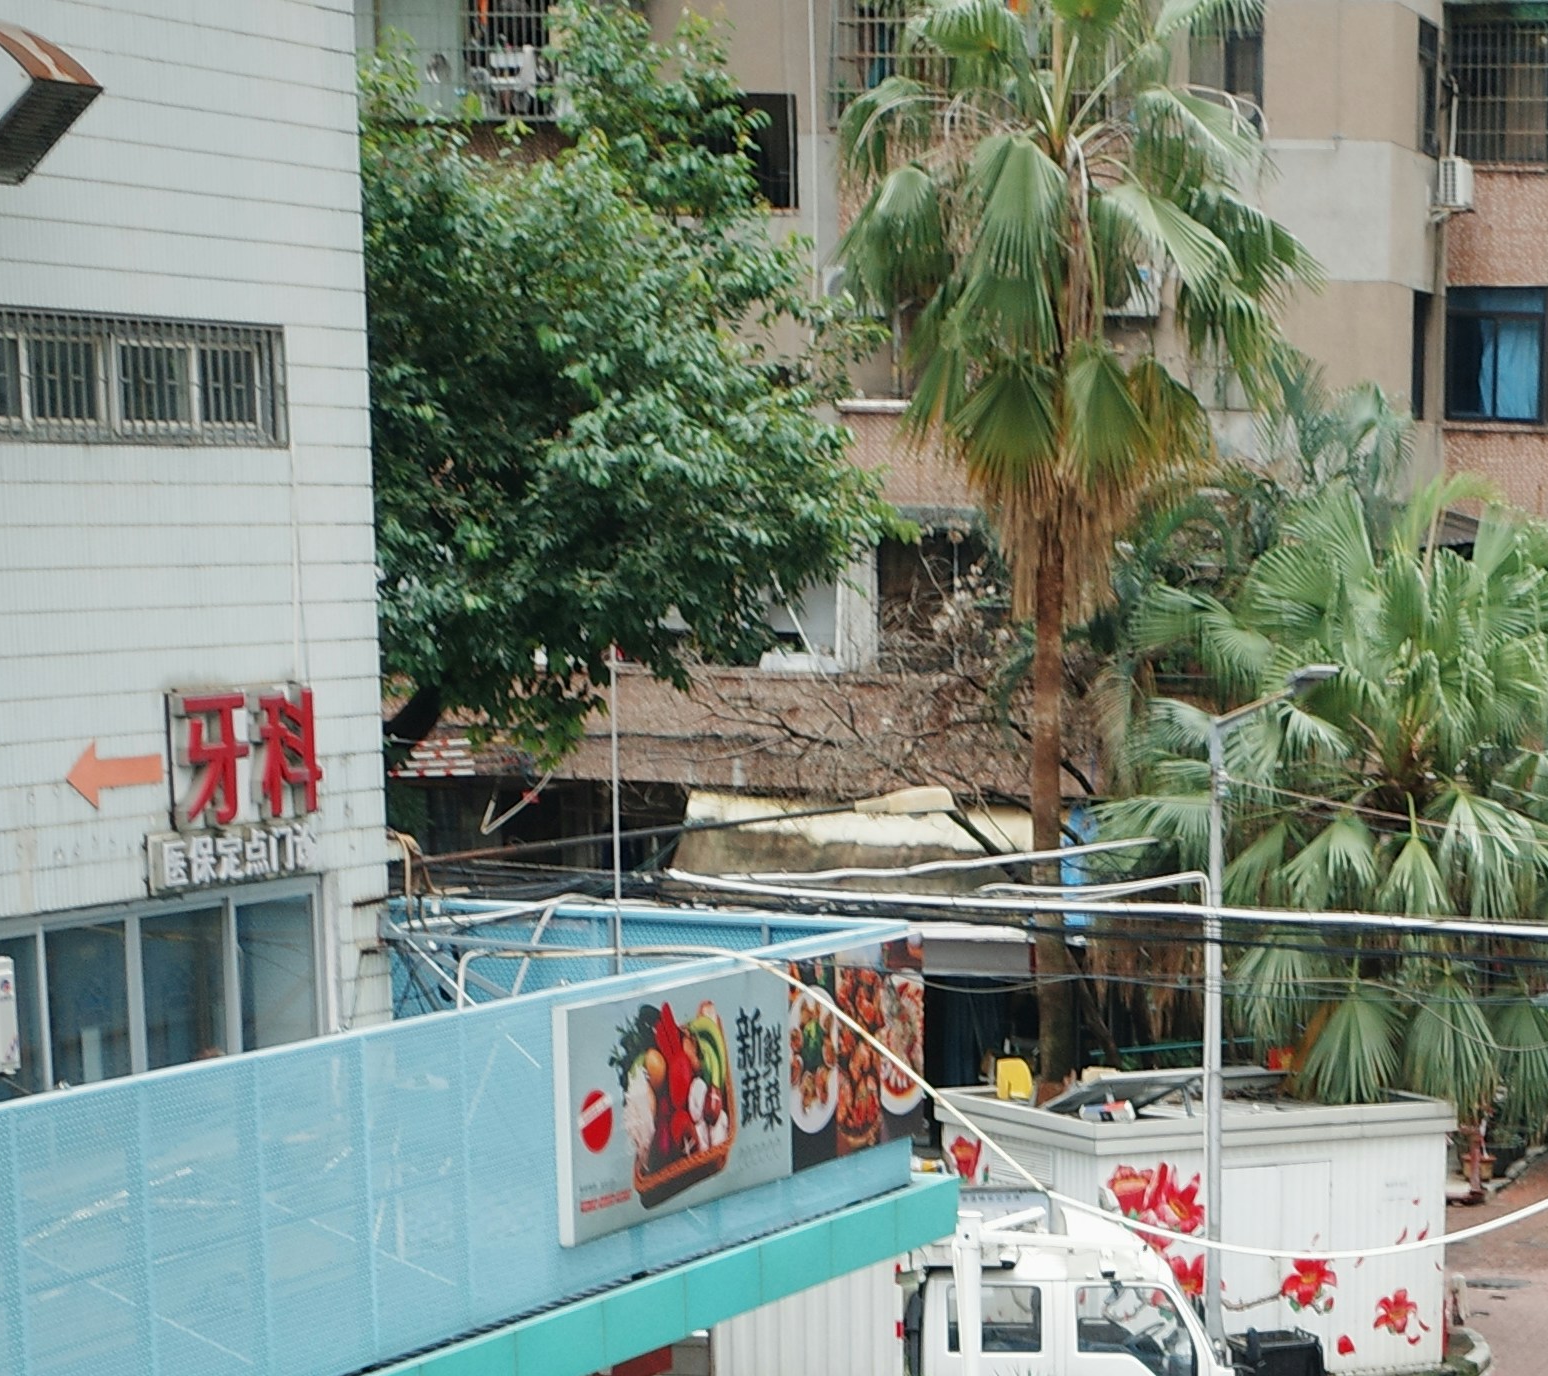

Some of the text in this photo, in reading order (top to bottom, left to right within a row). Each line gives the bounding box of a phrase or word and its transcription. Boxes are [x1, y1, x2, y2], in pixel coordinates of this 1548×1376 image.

[183, 687, 323, 825] 牙科
[161, 821, 319, 888] 医保定点门诊
[735, 1006, 783, 1078] 新鲜
[740, 1069, 783, 1133] 蔬菜
